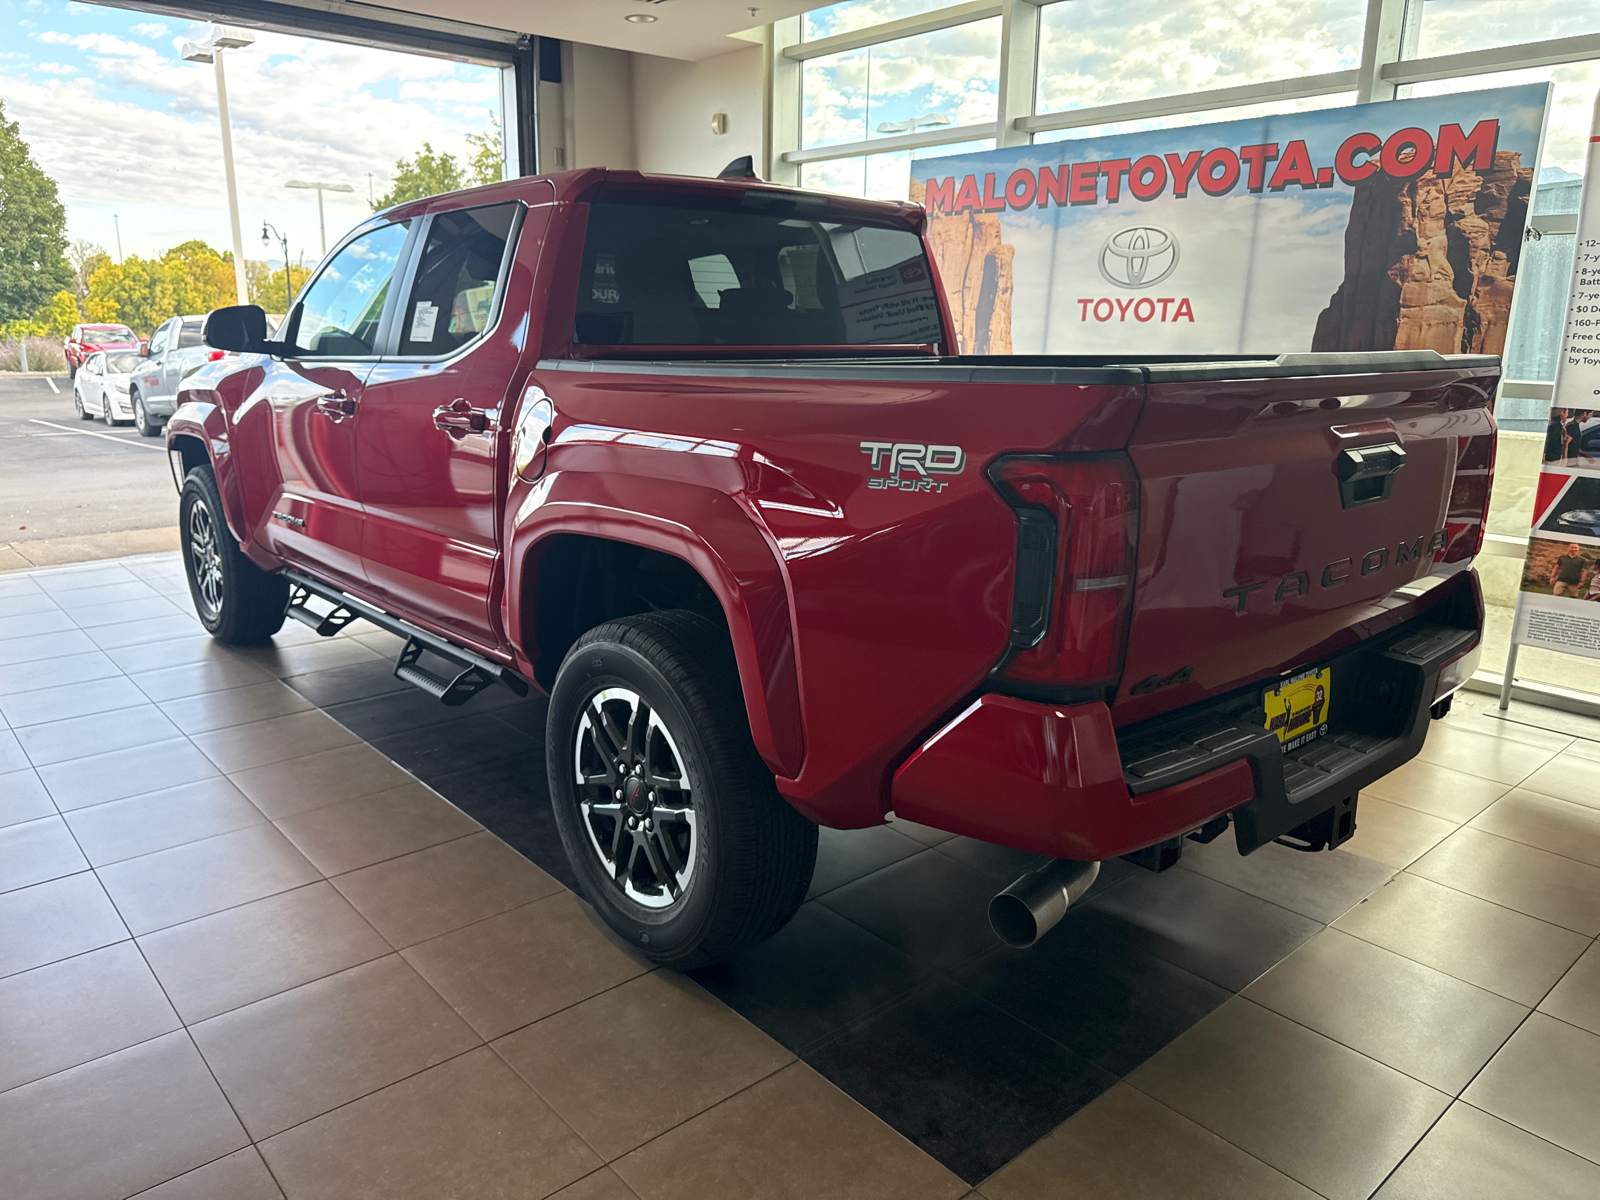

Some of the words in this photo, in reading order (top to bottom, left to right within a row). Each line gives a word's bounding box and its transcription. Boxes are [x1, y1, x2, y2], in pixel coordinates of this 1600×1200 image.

[925, 118, 1500, 217] MALONETOYOTA.COM
[1077, 296, 1195, 324] TOYOTA
[1576, 305, 1589, 314] $0
[1572, 332, 1593, 341] Free
[1568, 356, 1581, 366] by
[1582, 356, 1600, 367] Toy
[859, 441, 966, 481] TRD
[867, 477, 948, 493] SPORT
[1222, 528, 1448, 616] TACOMA
[1287, 737, 1300, 751] MAKE
[1306, 730, 1317, 743] EASY
